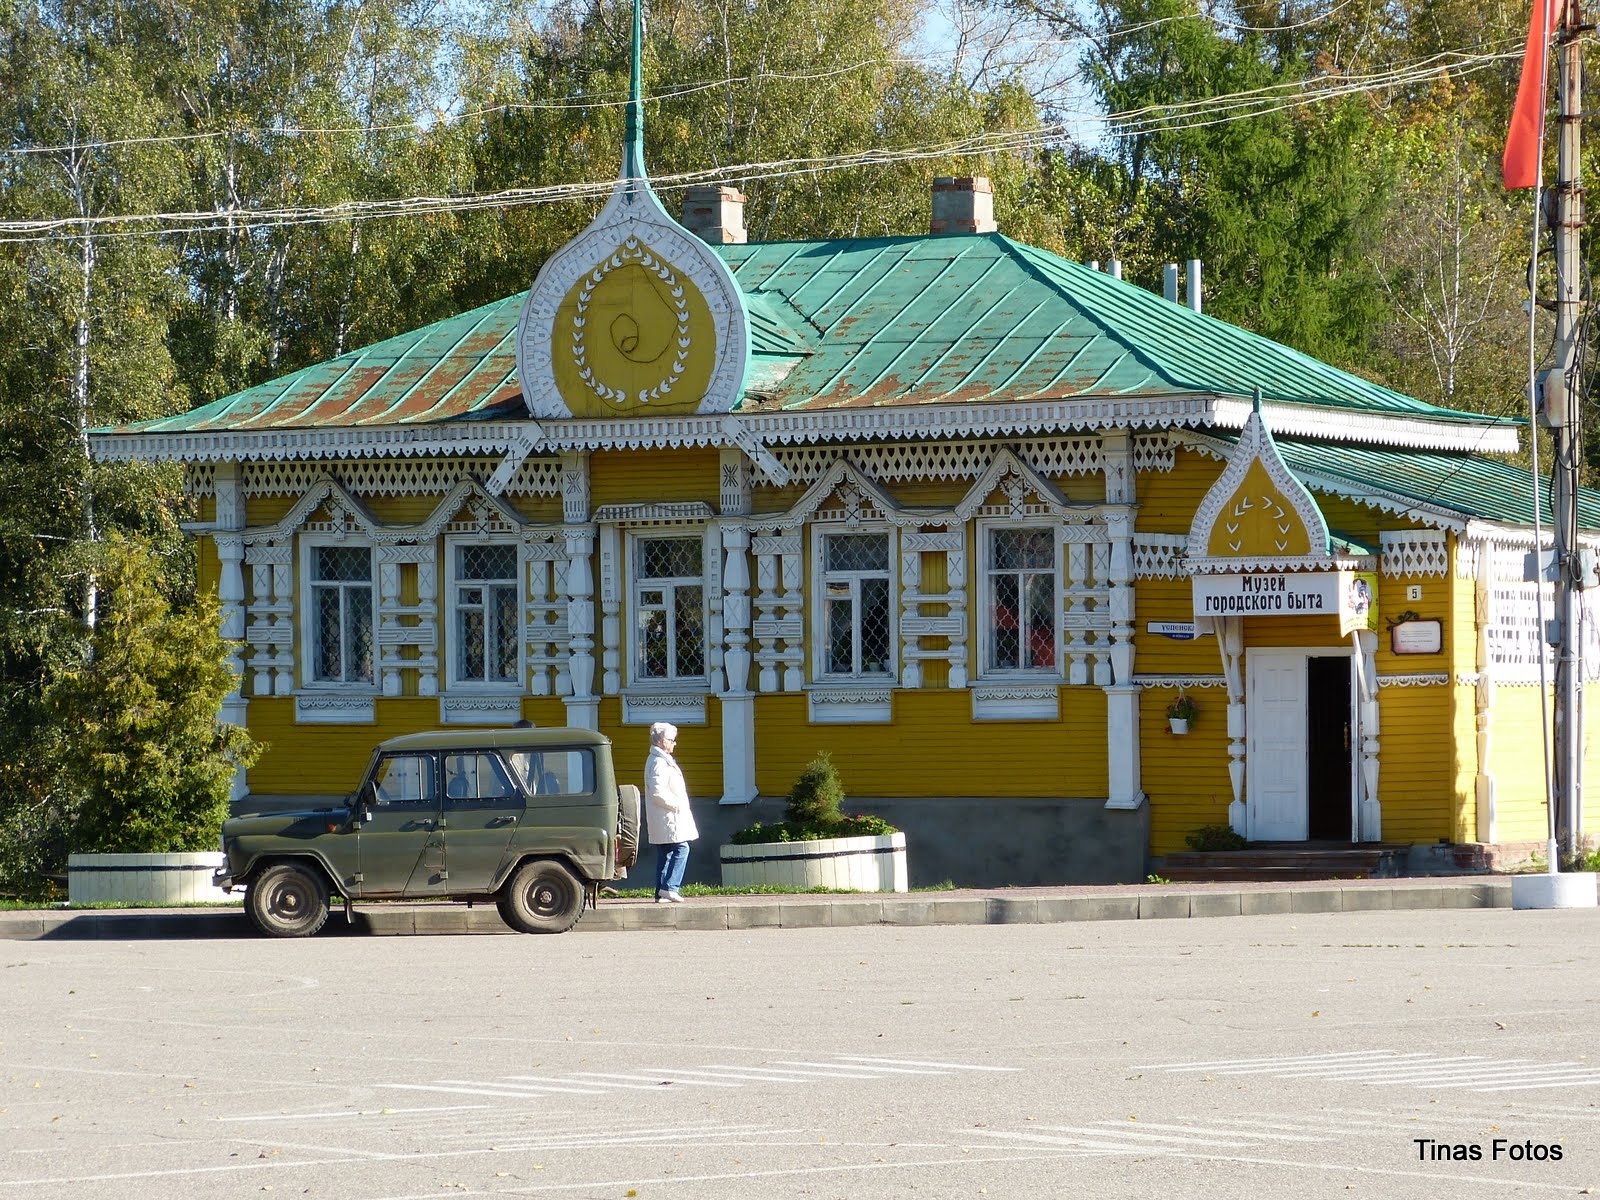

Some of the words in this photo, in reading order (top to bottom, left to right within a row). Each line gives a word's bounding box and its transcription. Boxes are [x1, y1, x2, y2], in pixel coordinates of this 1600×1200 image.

[1242, 575, 1286, 593] Музей
[1205, 594, 1282, 613] городского
[1287, 592, 1323, 609] быта
[1411, 588, 1418, 599] 5
